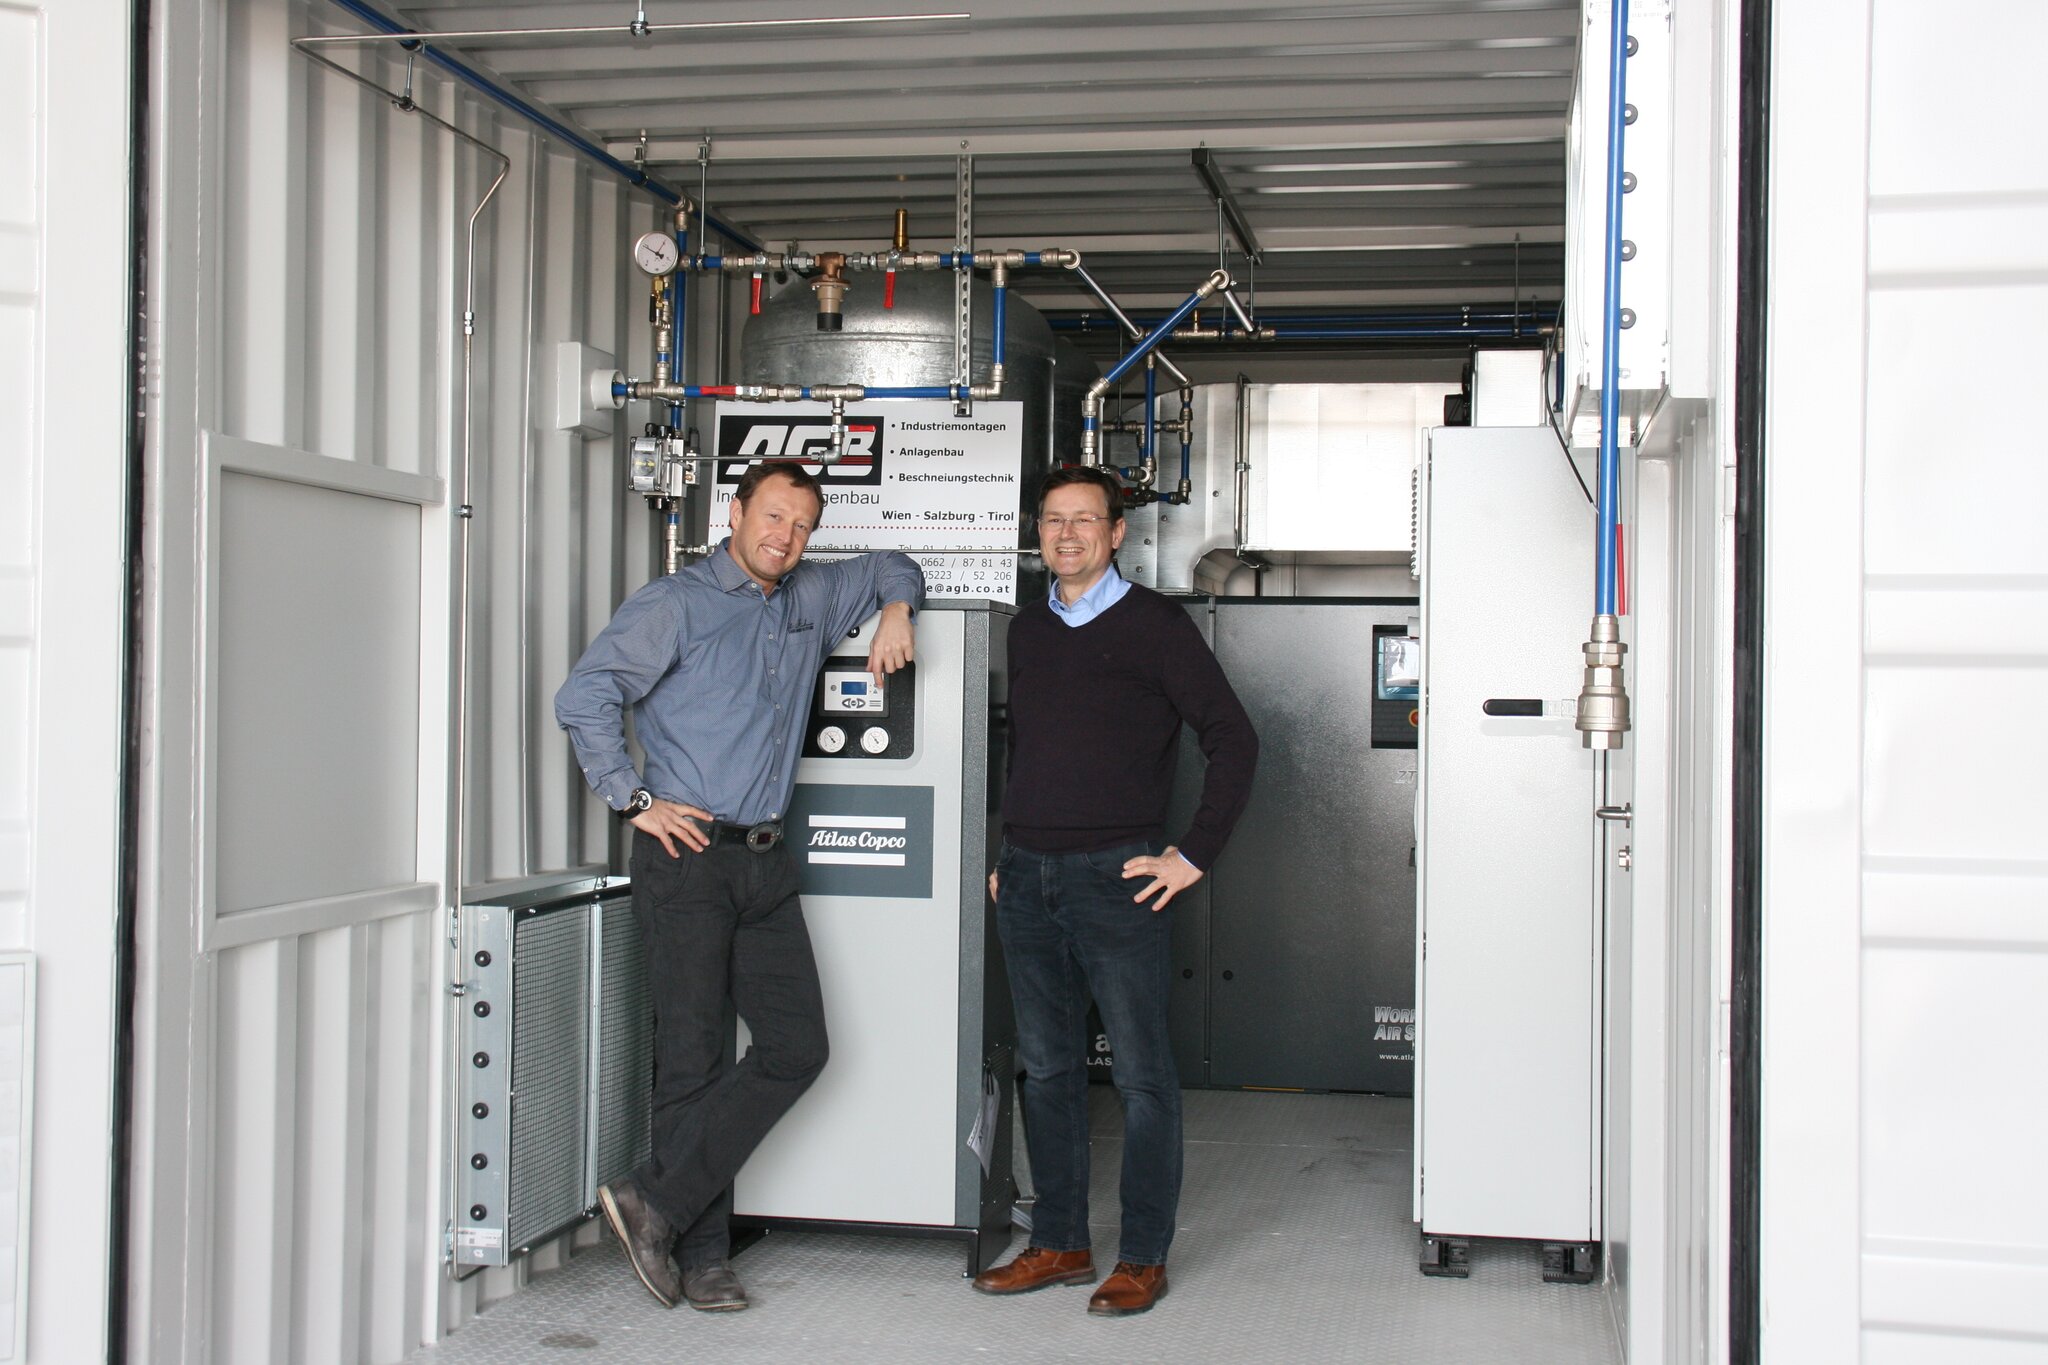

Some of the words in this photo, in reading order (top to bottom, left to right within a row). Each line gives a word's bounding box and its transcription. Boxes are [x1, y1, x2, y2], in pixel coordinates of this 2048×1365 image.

[900, 422, 1006, 433] Industriemontagen
[725, 425, 876, 476] AGB
[899, 447, 964, 458] Anlagenbau
[898, 473, 1015, 484] Beschneiungstechnik
[882, 510, 912, 520] Wien
[923, 510, 975, 523] Salzburg
[987, 511, 1014, 521] Tirol
[921, 558, 945, 567] 0662
[962, 558, 975, 567] 87
[981, 558, 993, 567] 81
[1000, 559, 1012, 568] 43
[923, 570, 952, 580] 05223
[973, 571, 985, 580] 52
[993, 571, 1012, 580] 206
[808, 830, 857, 847] Atlas
[858, 831, 906, 851] Copco
[1374, 1024, 1402, 1041] AIR
